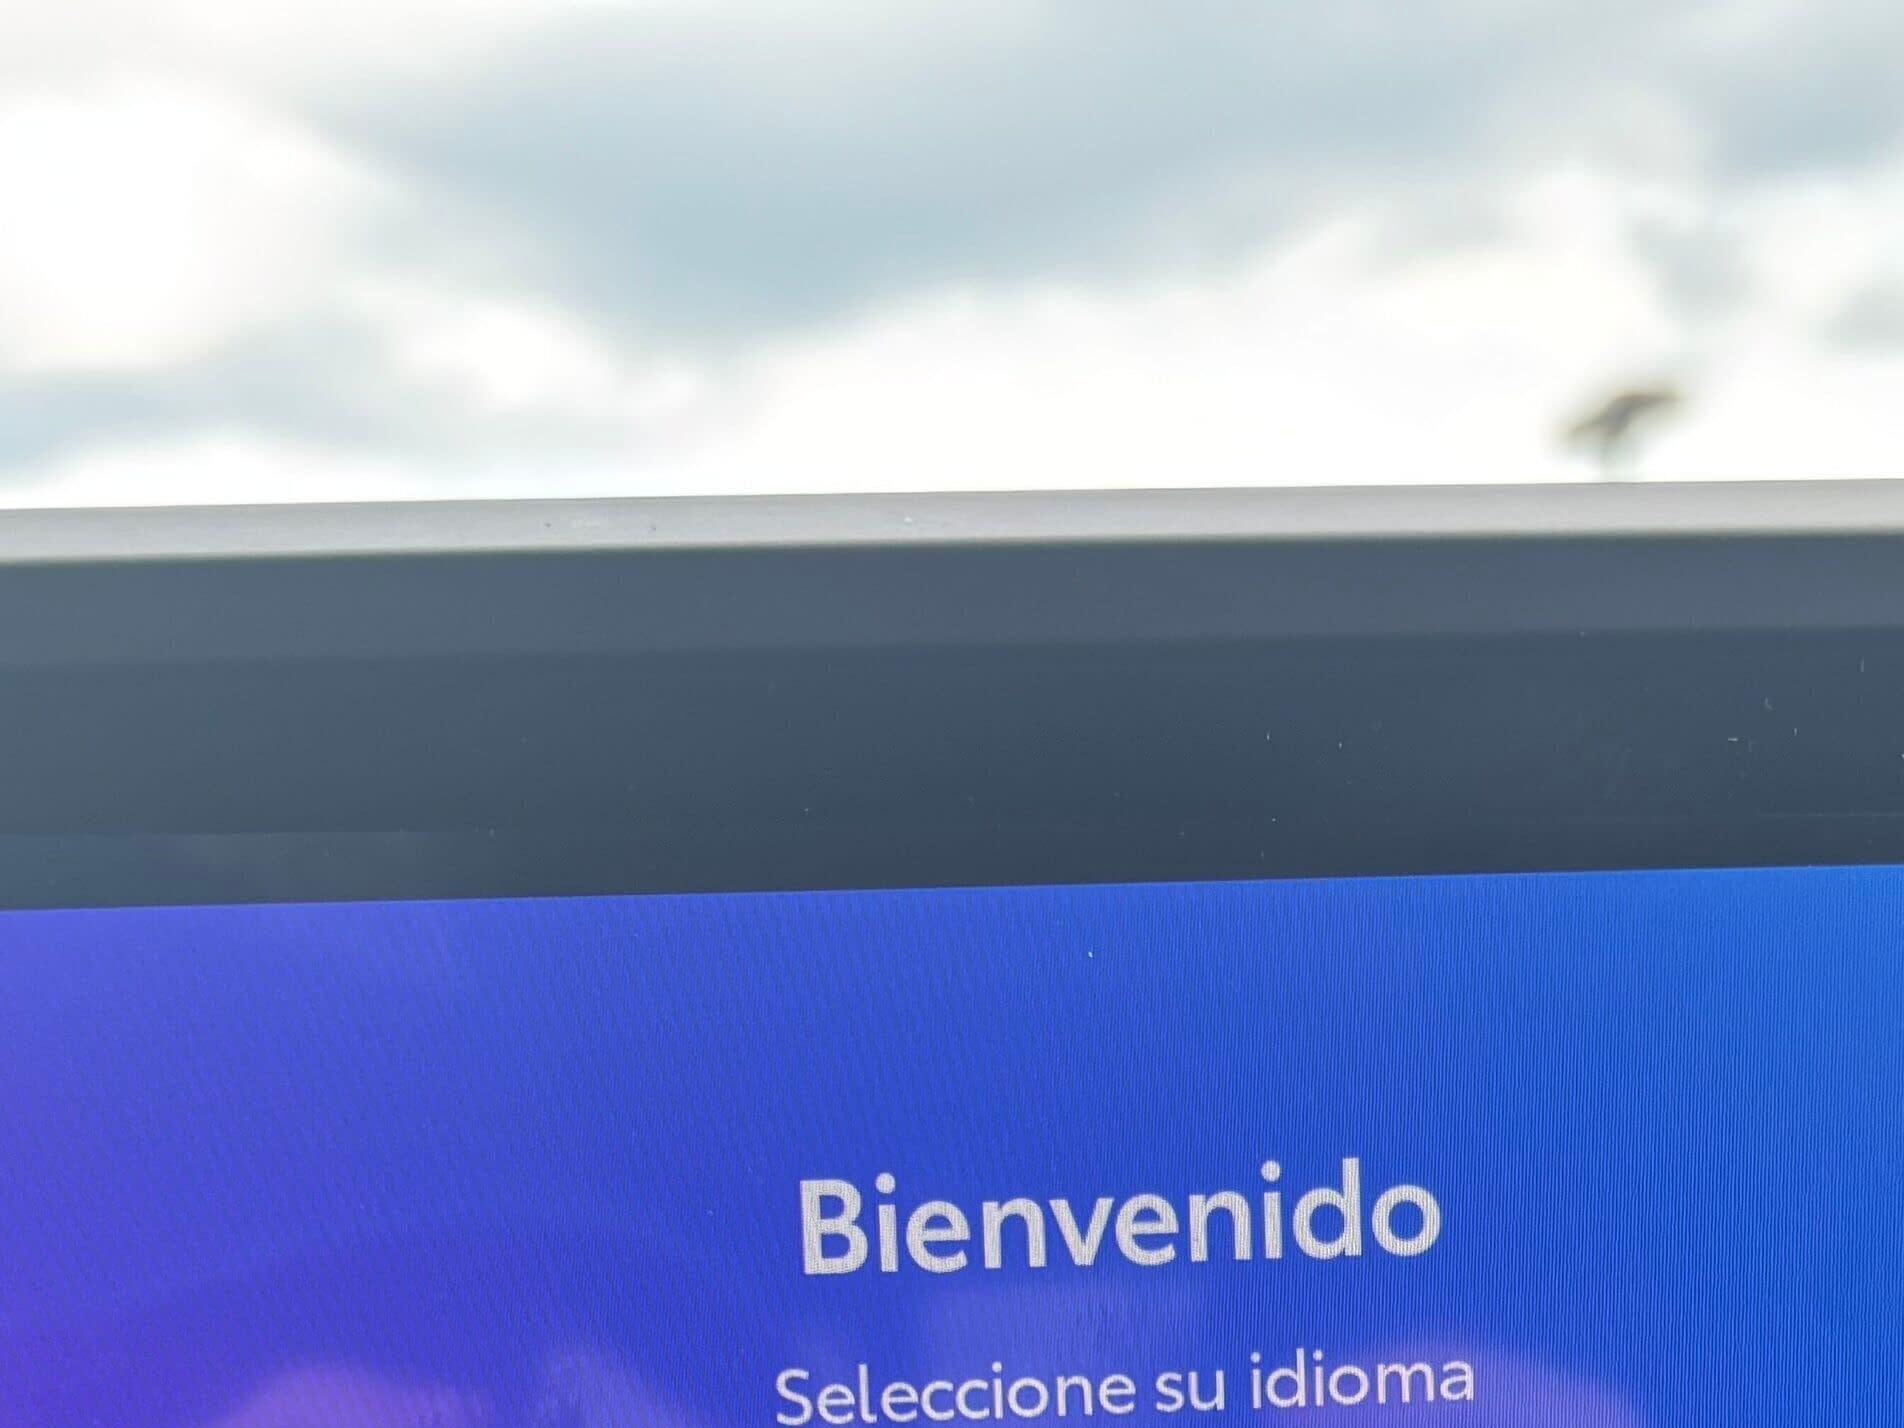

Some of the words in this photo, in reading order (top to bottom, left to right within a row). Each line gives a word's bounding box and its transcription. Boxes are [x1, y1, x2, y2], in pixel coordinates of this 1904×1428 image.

[798, 1156, 1443, 1276] Bienvenido
[775, 1360, 1136, 1427] Seleccione
[1154, 1364, 1226, 1412] su
[1249, 1348, 1477, 1409] idioma
